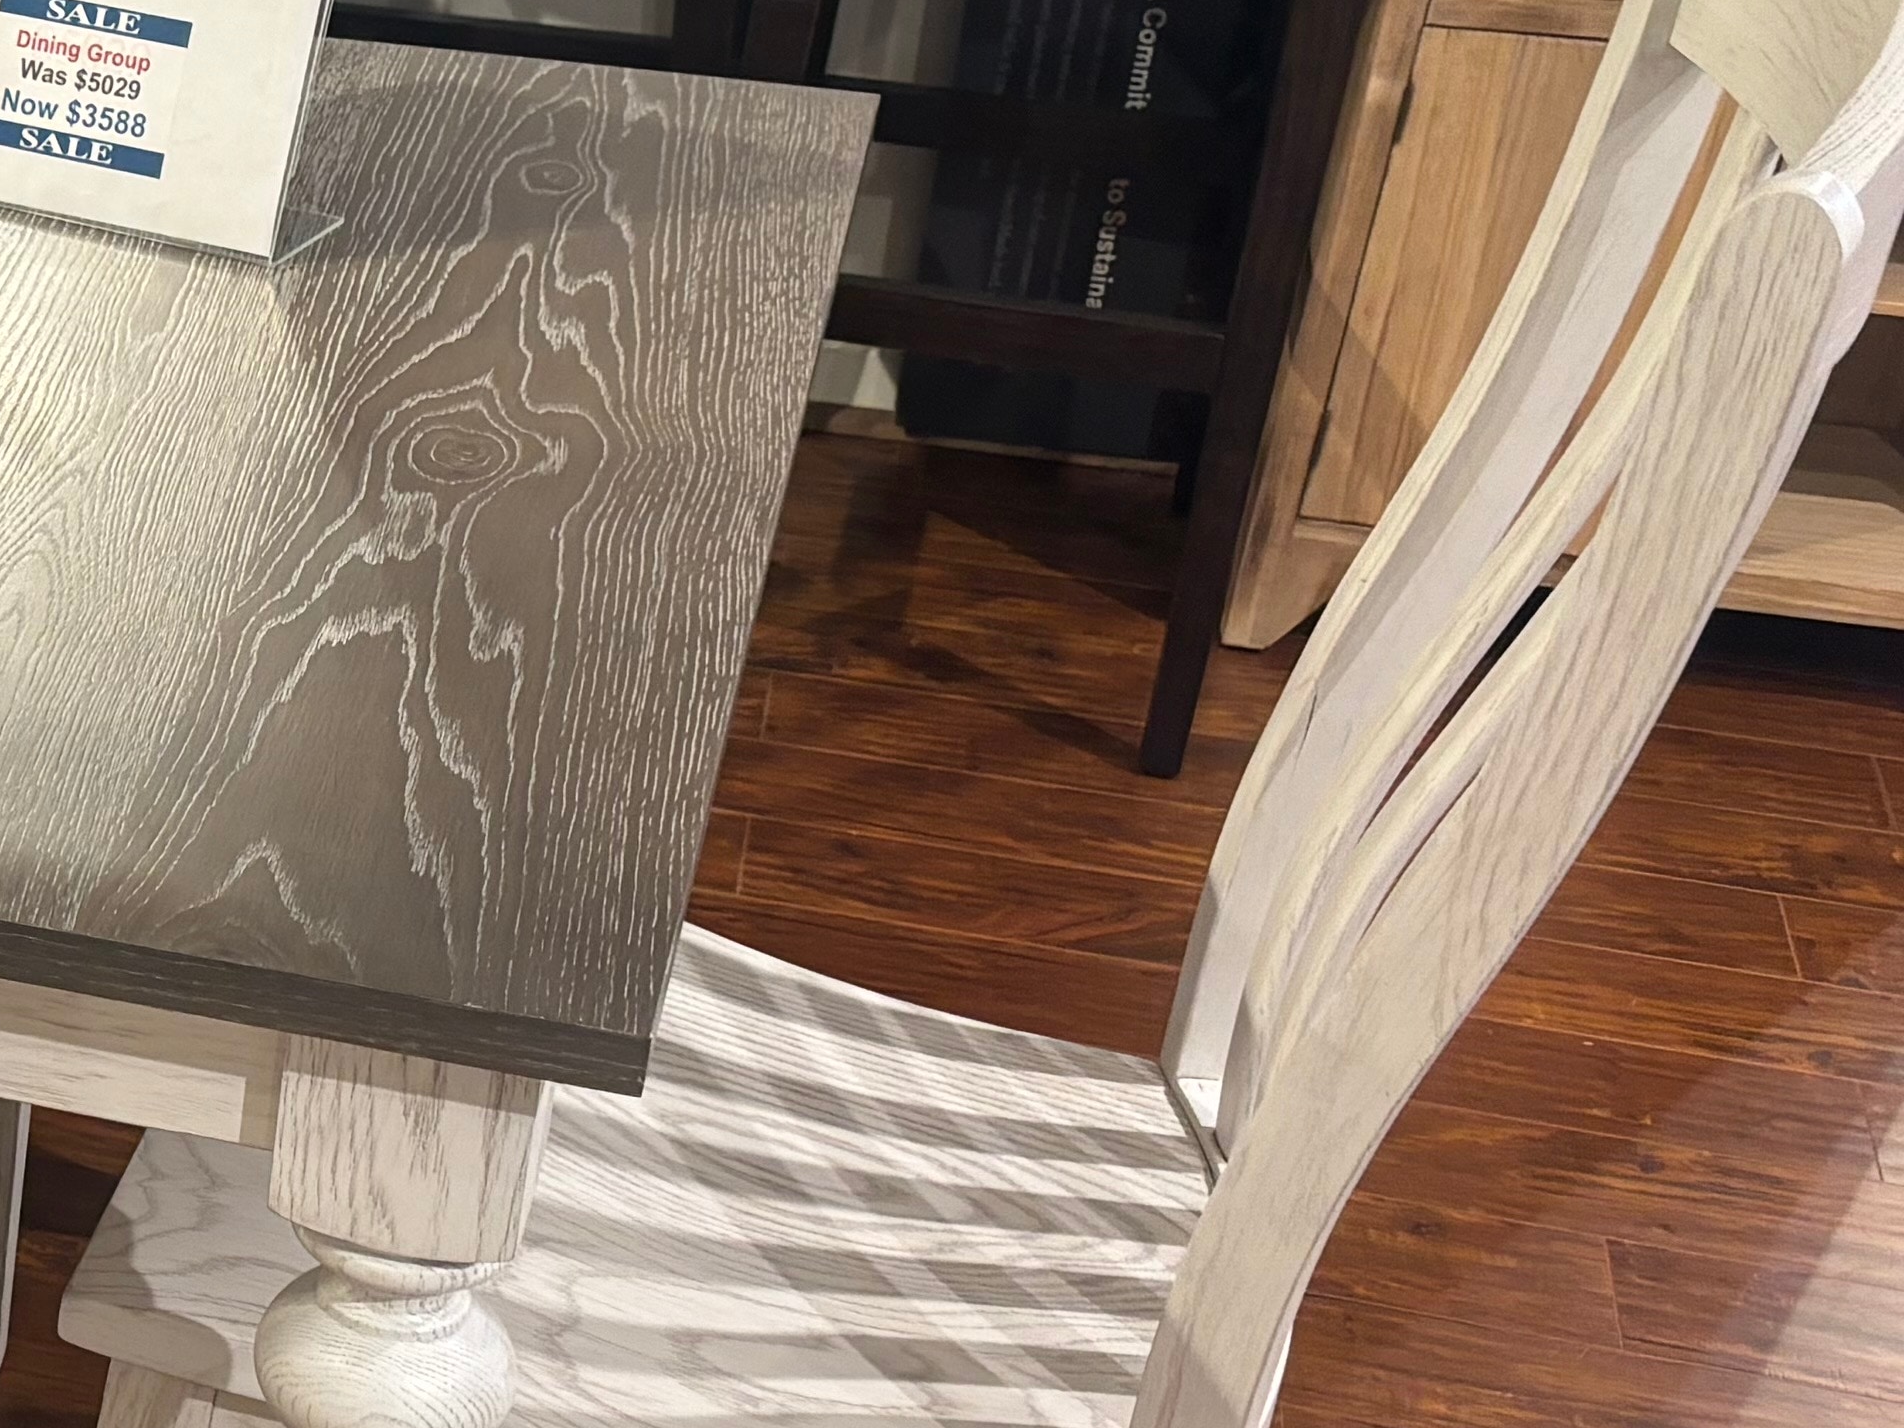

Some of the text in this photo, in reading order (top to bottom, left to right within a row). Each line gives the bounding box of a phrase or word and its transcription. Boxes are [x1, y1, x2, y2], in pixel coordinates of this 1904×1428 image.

[16, 29, 151, 75] Dining Group
[1124, 7, 1167, 110] Commit
[21, 58, 142, 100] Was $5029
[1, 87, 147, 138] Now $3588
[19, 127, 113, 165] SALE
[1086, 178, 1130, 308] to Sustaina
